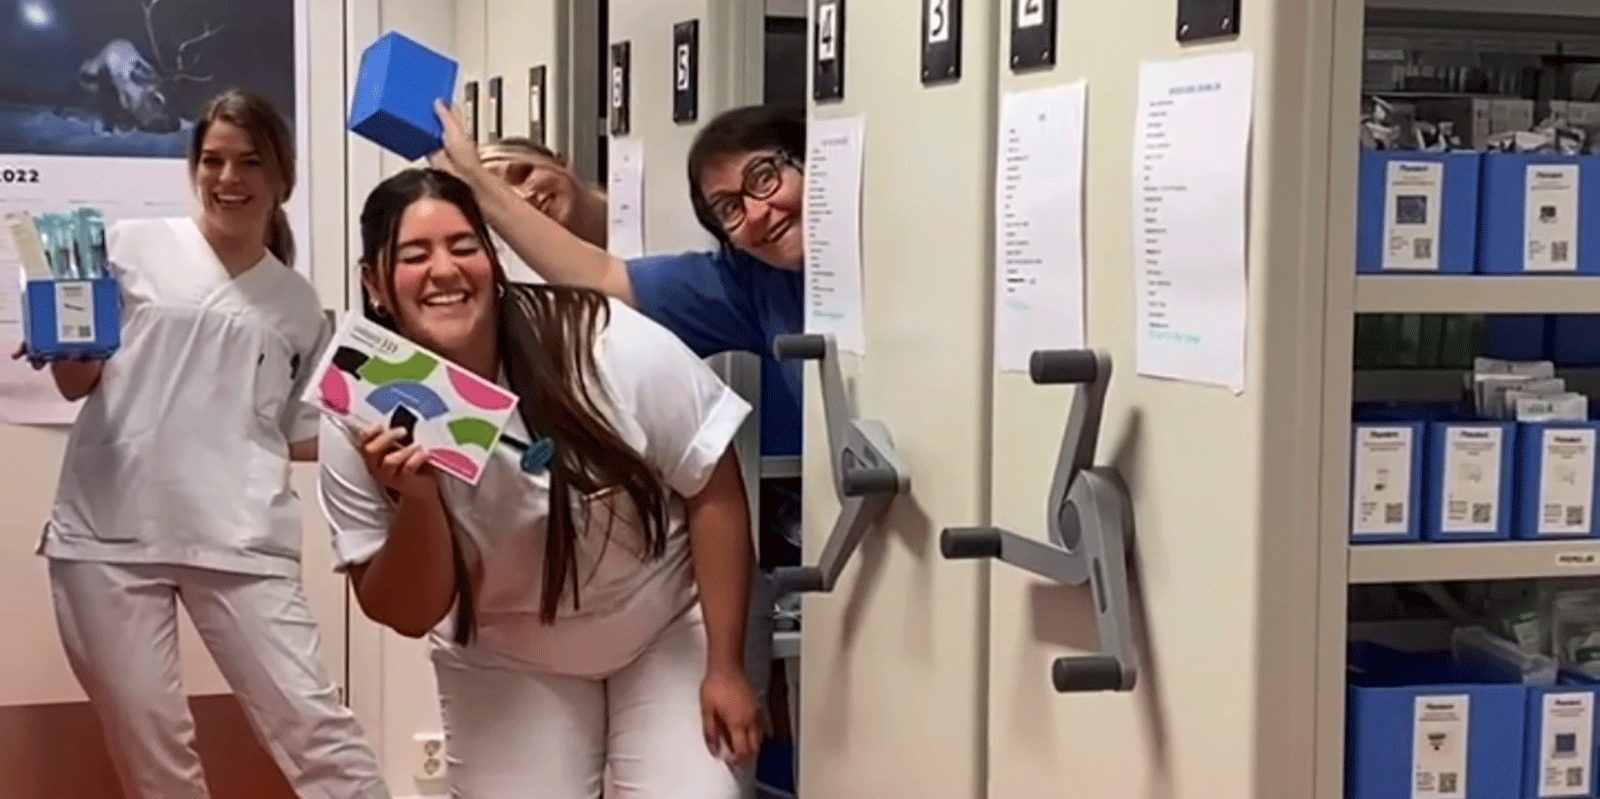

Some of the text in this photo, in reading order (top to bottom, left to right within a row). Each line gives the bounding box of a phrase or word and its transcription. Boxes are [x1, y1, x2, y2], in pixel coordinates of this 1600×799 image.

[822, 9, 832, 52] 4
[679, 49, 688, 86] 5
[0, 169, 39, 182] 022
